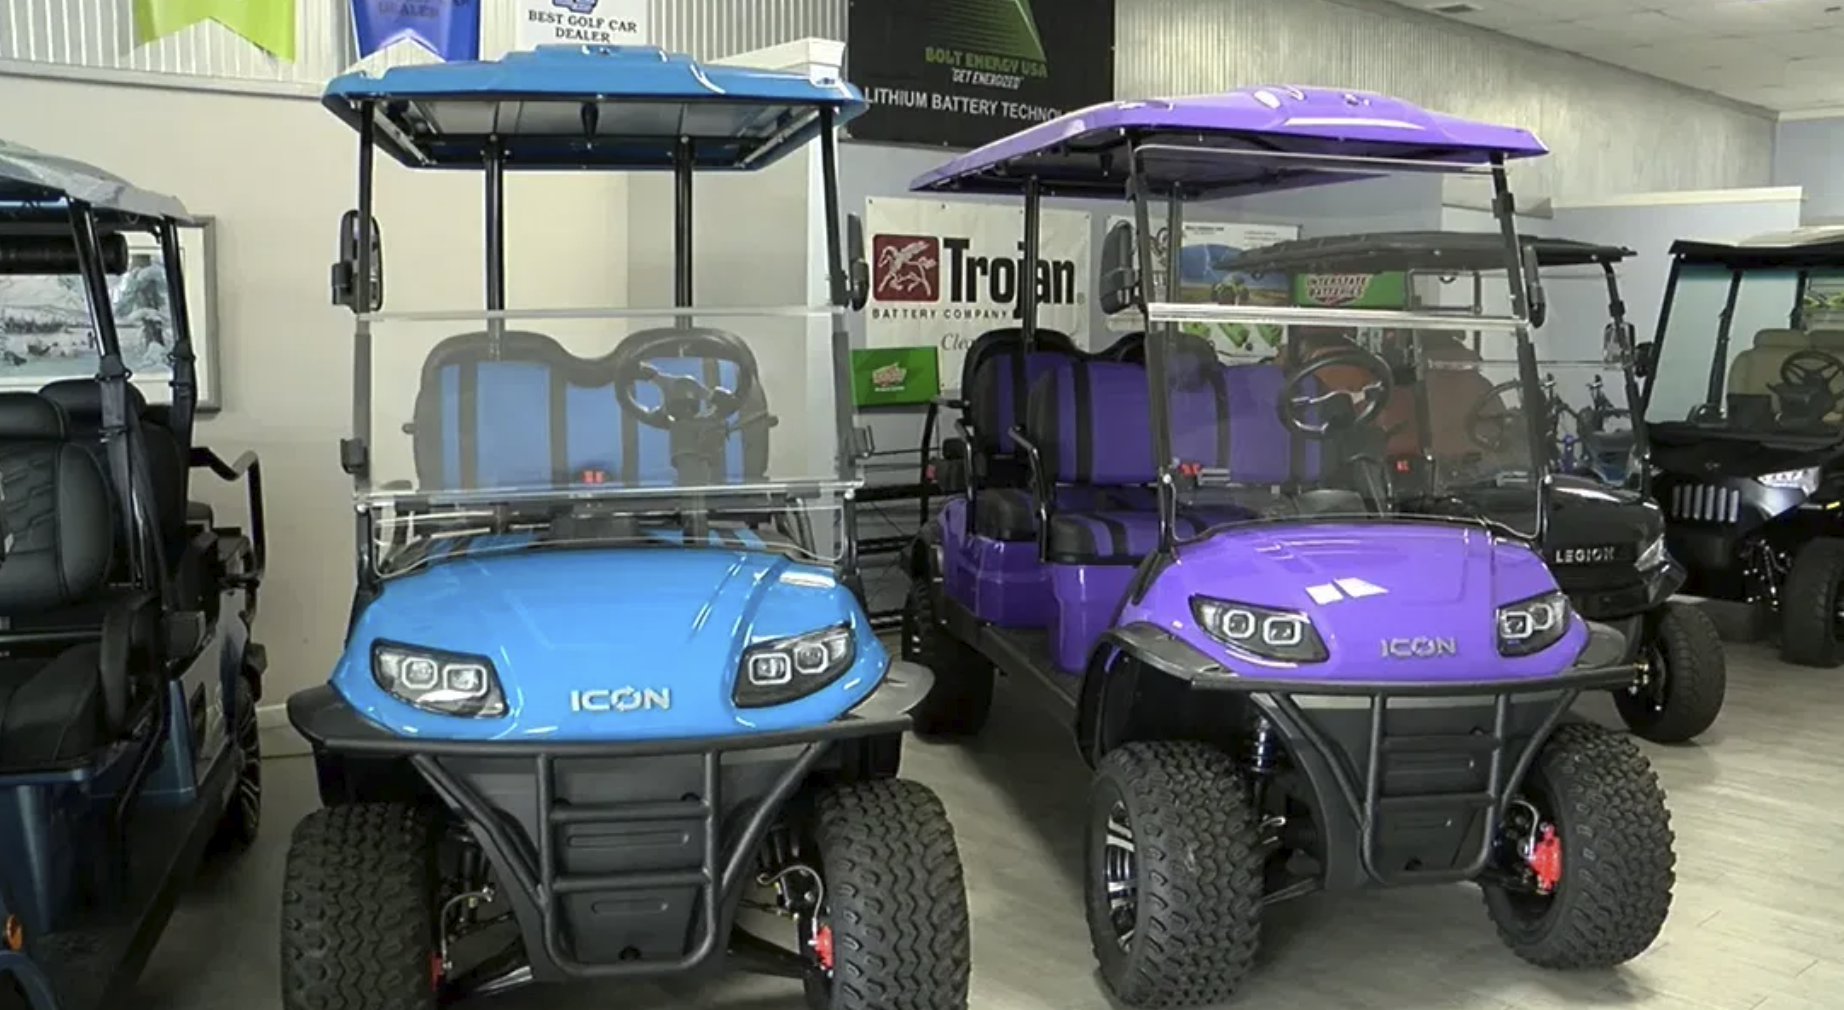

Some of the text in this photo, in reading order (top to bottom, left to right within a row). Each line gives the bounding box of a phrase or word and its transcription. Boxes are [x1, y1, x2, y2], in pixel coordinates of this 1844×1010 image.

[528, 9, 638, 33] BEST GOLF CAR
[555, 26, 611, 43] DEALER
[924, 46, 1048, 79] BOLT ENERGY USA
[865, 86, 928, 109] LITHIUM
[931, 93, 998, 117] BATTERY
[943, 237, 1076, 319] Trojan
[872, 307, 1008, 320] BATTERY COMPANY
[1555, 546, 1616, 563] LEGION
[1380, 636, 1456, 658] ICON
[570, 686, 671, 712] ICON
